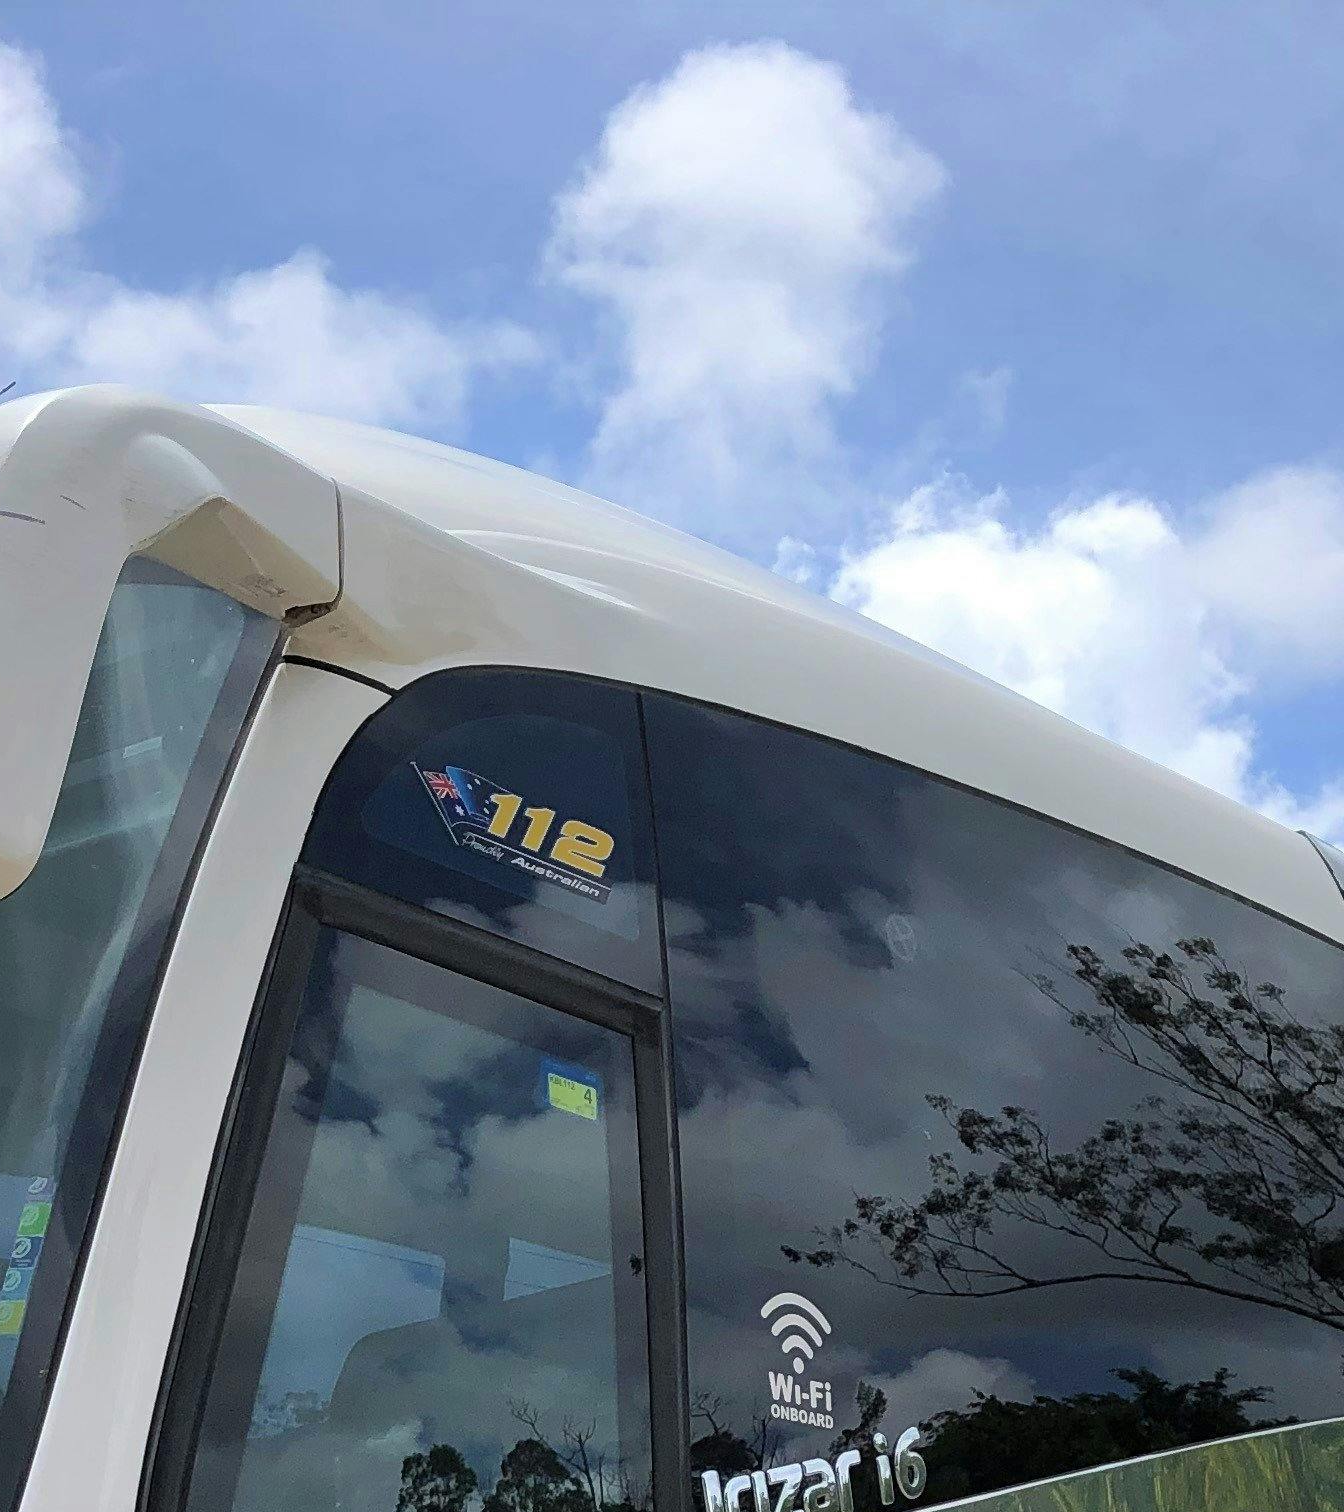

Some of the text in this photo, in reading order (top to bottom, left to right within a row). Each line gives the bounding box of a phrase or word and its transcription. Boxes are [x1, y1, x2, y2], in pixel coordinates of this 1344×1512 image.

[487, 793, 615, 877] 112
[510, 856, 600, 897] Australian
[583, 1088, 593, 1104] 4
[768, 1371, 833, 1412] Wi-Fi
[770, 1403, 834, 1430] ONBOARD
[873, 1426, 927, 1506] i6
